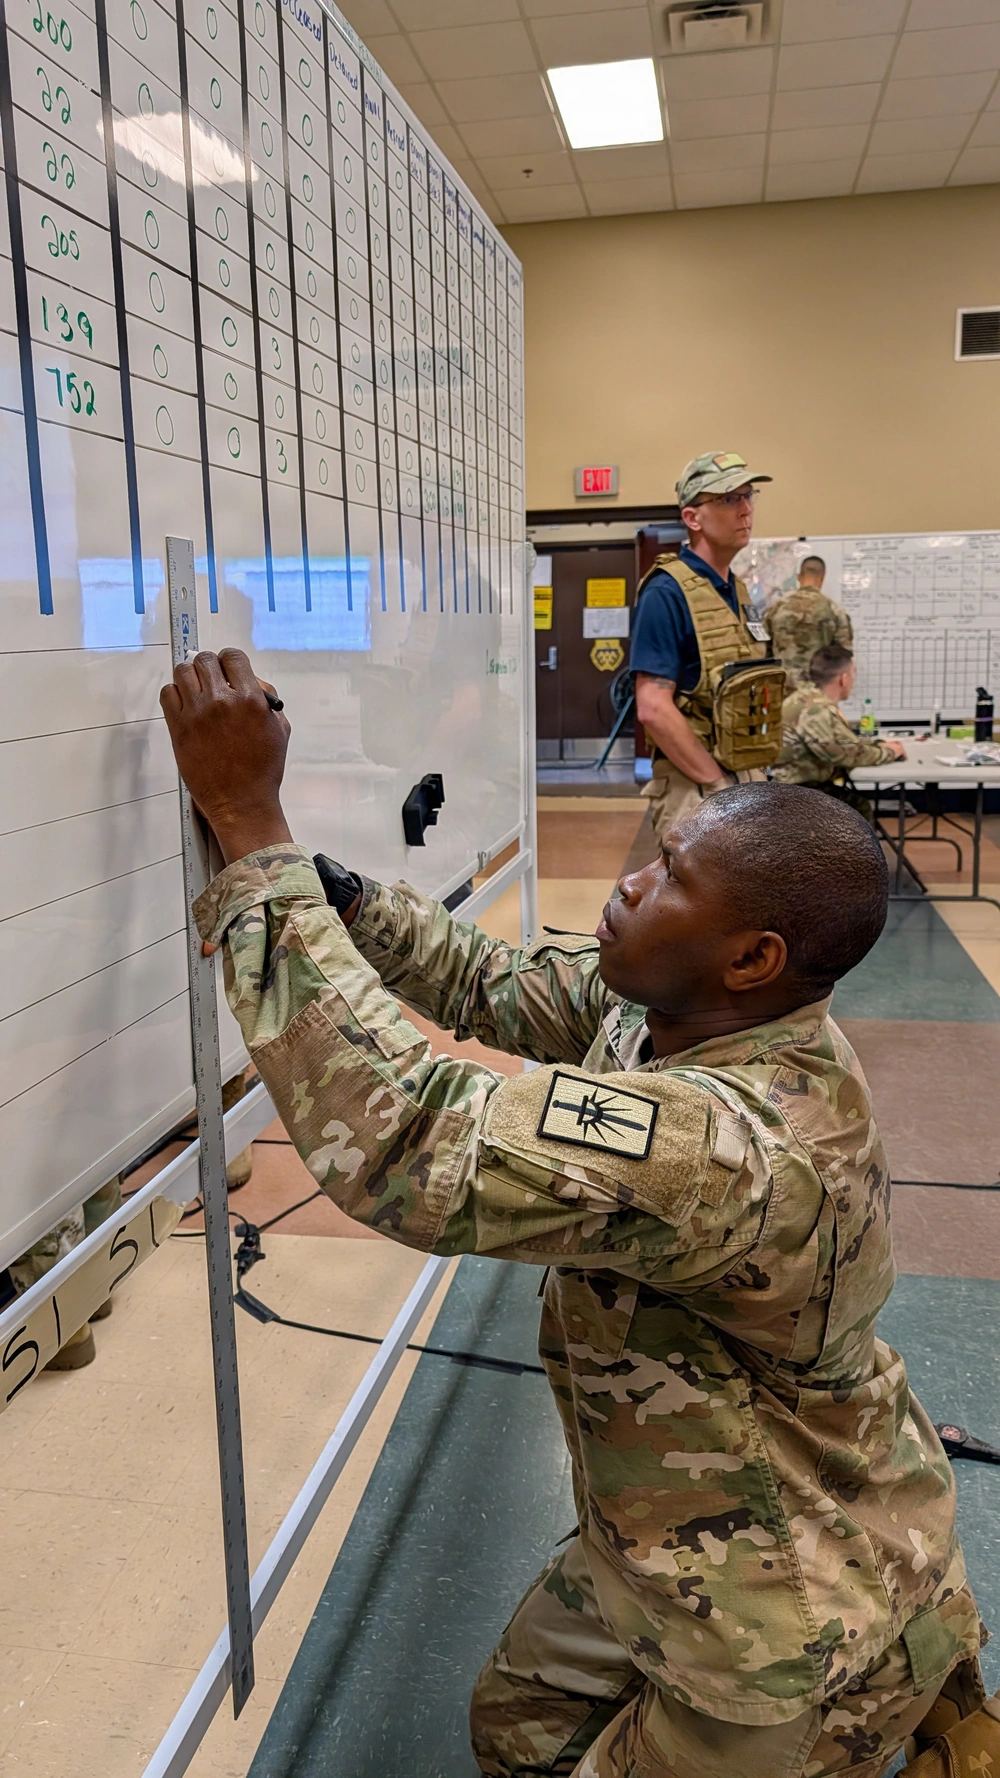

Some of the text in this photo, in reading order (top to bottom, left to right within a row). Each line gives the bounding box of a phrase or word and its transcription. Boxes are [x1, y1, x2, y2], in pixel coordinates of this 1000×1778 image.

[26, 0, 72, 52] 200
[138, 82, 154, 120] 0
[212, 147, 225, 177] 0
[264, 182, 276, 218] 0
[305, 222, 314, 252] 0
[347, 256, 357, 279] 0
[376, 279, 384, 302] 0
[130, 0, 148, 41] 0
[210, 78, 222, 109] 0
[260, 122, 274, 157] 0
[302, 174, 314, 203] 0
[345, 207, 356, 234] 0
[374, 233, 381, 259] 0
[206, 7, 218, 40] 0
[258, 65, 270, 101] 0
[302, 114, 313, 146] 0
[343, 156, 352, 184] 0
[372, 184, 379, 208] 0
[254, 2, 266, 38] 0
[299, 58, 312, 88] 0
[337, 100, 346, 124] 0
[371, 141, 378, 161] 0
[329, 42, 358, 90] Detained
[36, 66, 72, 124] 22
[141, 150, 159, 188] 0
[215, 207, 229, 241] 0
[266, 243, 275, 270] 0
[307, 270, 317, 298] 0
[350, 298, 359, 320] 0
[378, 320, 386, 343] 0
[43, 141, 76, 189] 22
[144, 210, 160, 249] 0
[218, 258, 231, 287] 0
[268, 287, 280, 318] 0
[310, 316, 320, 343] 0
[351, 342, 361, 364] 0
[380, 359, 388, 384] 0
[41, 215, 80, 261] 205
[148, 271, 166, 313] 0
[221, 316, 238, 347] 0
[271, 337, 282, 370] 3
[312, 363, 323, 394] 0
[353, 384, 363, 406] 0
[382, 403, 389, 424] 0
[41, 296, 93, 350] 139
[152, 344, 169, 379] 0
[224, 372, 238, 400] 0
[275, 395, 285, 419] 0
[315, 409, 326, 440] 0
[354, 428, 364, 450] 0
[383, 438, 390, 460] 0
[45, 367, 97, 416] 752
[155, 405, 174, 446] 0
[227, 427, 241, 459] 0
[275, 439, 288, 474] 3
[318, 458, 328, 485] 0
[355, 464, 366, 492] 0
[385, 478, 393, 505] 0
[583, 468, 612, 492] EXIT
